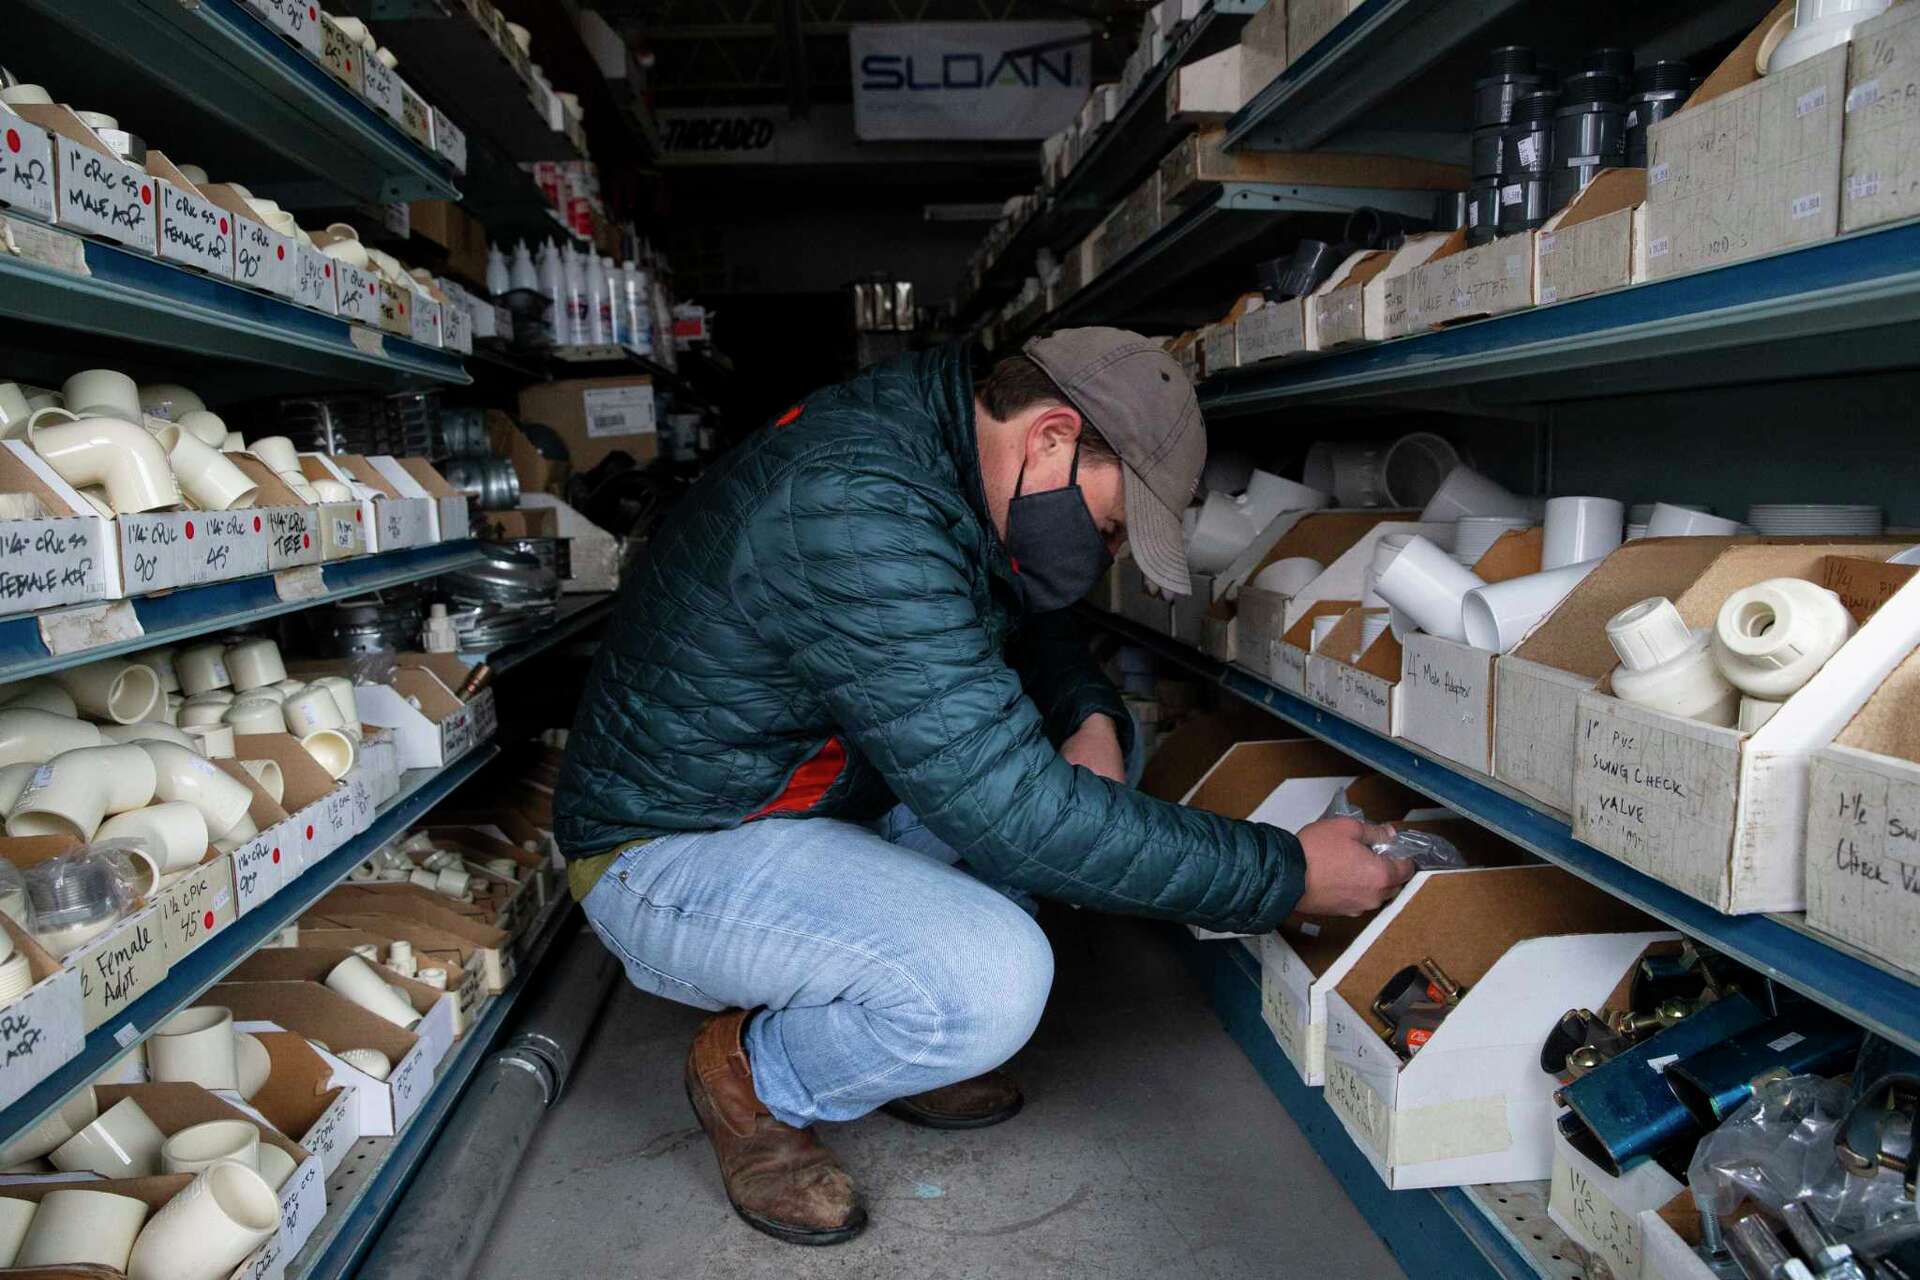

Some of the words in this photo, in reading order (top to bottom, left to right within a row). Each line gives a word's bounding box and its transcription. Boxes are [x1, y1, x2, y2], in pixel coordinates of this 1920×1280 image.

[861, 50, 1074, 89] SLOAN
[656, 118, 774, 150] THREADED
[69, 188, 110, 219] MALE
[273, 534, 302, 558] TEE
[1612, 730, 1635, 750] PVC
[1592, 752, 1629, 784] SWING
[1599, 795, 1645, 824] VALVE
[96, 925, 153, 979] Female
